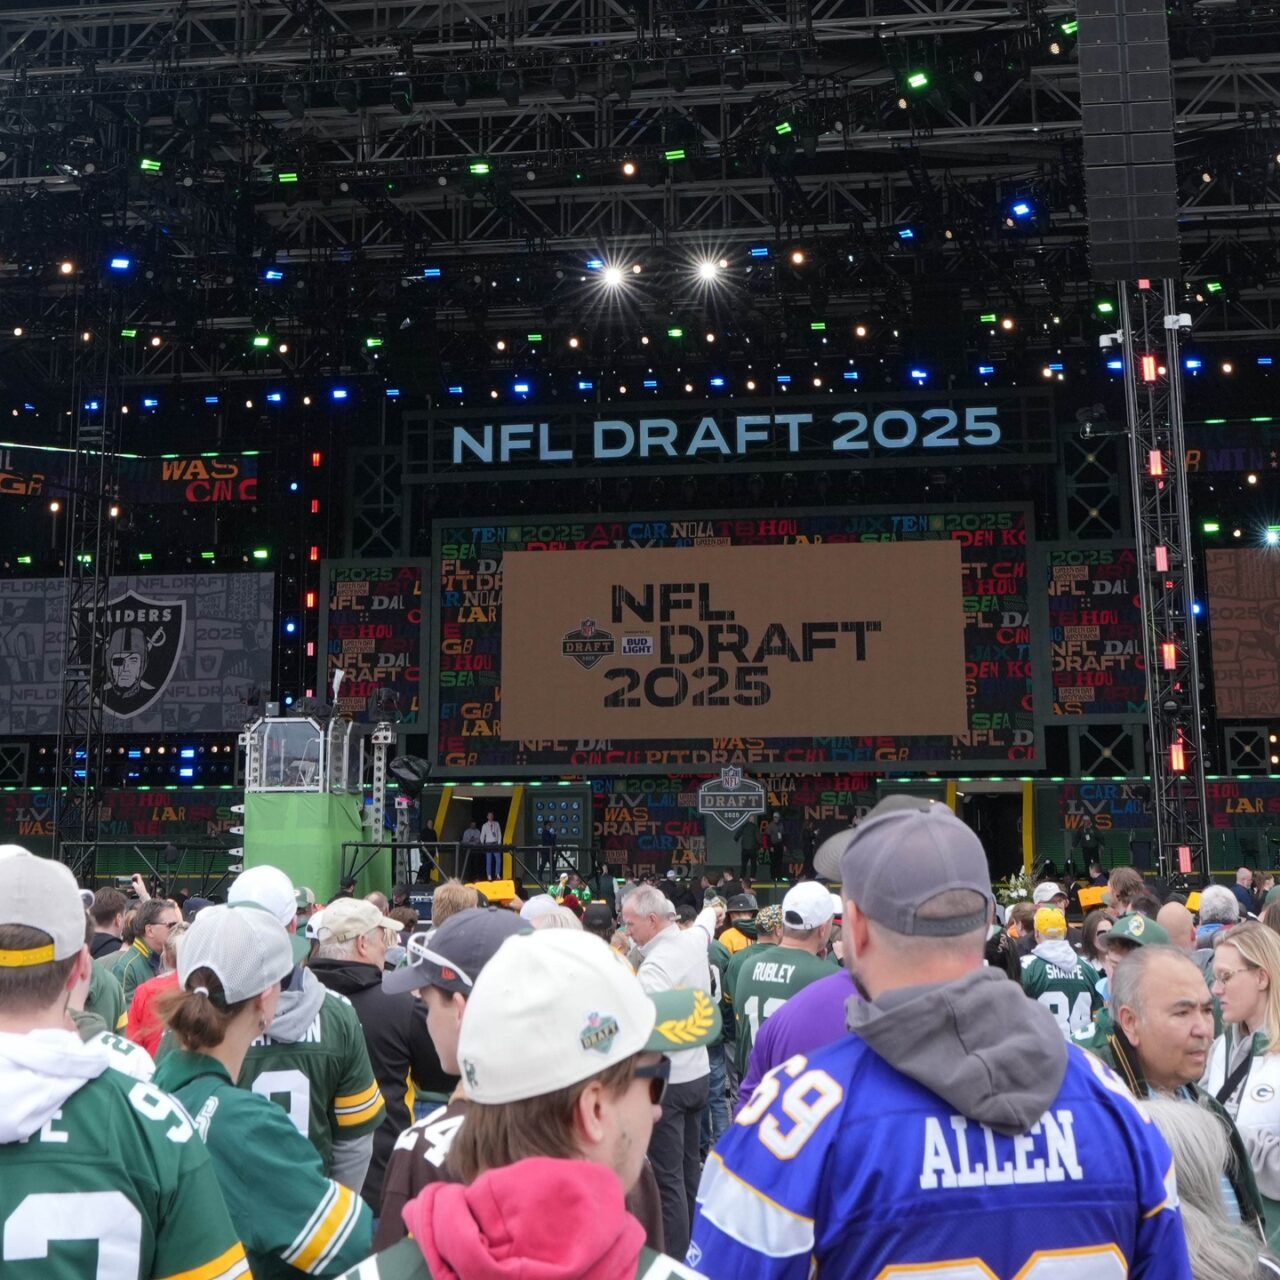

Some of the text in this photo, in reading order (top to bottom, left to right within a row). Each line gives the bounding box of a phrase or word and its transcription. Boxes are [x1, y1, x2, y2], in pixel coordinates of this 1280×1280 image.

[453, 406, 1002, 464] NFL DRAFT 2025
[161, 458, 238, 481] WAS
[472, 513, 1011, 543] TEN 2025 CAR NOLA TEN 2025
[441, 543, 477, 559] SEA
[1051, 550, 1113, 565] 2025
[335, 568, 393, 582] 2025
[1092, 579, 1129, 595] DAL
[371, 595, 405, 610] DAL
[612, 582, 735, 623] NFL
[962, 595, 1000, 612] SEA
[458, 606, 496, 623] LAR
[566, 642, 611, 652] DRAFT
[623, 646, 651, 654] LIGHT
[627, 638, 648, 646] BUD
[660, 621, 882, 664] DRAFT
[1051, 639, 1141, 656] NFL DAL
[328, 652, 410, 667] NFL DAL
[440, 672, 476, 687] SEA
[604, 666, 771, 708] 2025
[971, 713, 1010, 729] SEA
[952, 730, 1005, 746] NFL
[646, 749, 780, 765] PIT DRAFT
[626, 779, 683, 793] 2025
[1079, 784, 1119, 799] CAR
[607, 793, 646, 808] LV
[704, 795, 760, 807] DRAFT
[1067, 799, 1108, 814] LV
[1226, 798, 1265, 814] LAR
[152, 806, 186, 821] LAR
[603, 806, 649, 821] WAS
[804, 805, 848, 820] NFL
[752, 961, 795, 984] RUBLEY
[581, 1020, 618, 1050] DRAFT
[920, 1109, 1083, 1190] ALLEN
